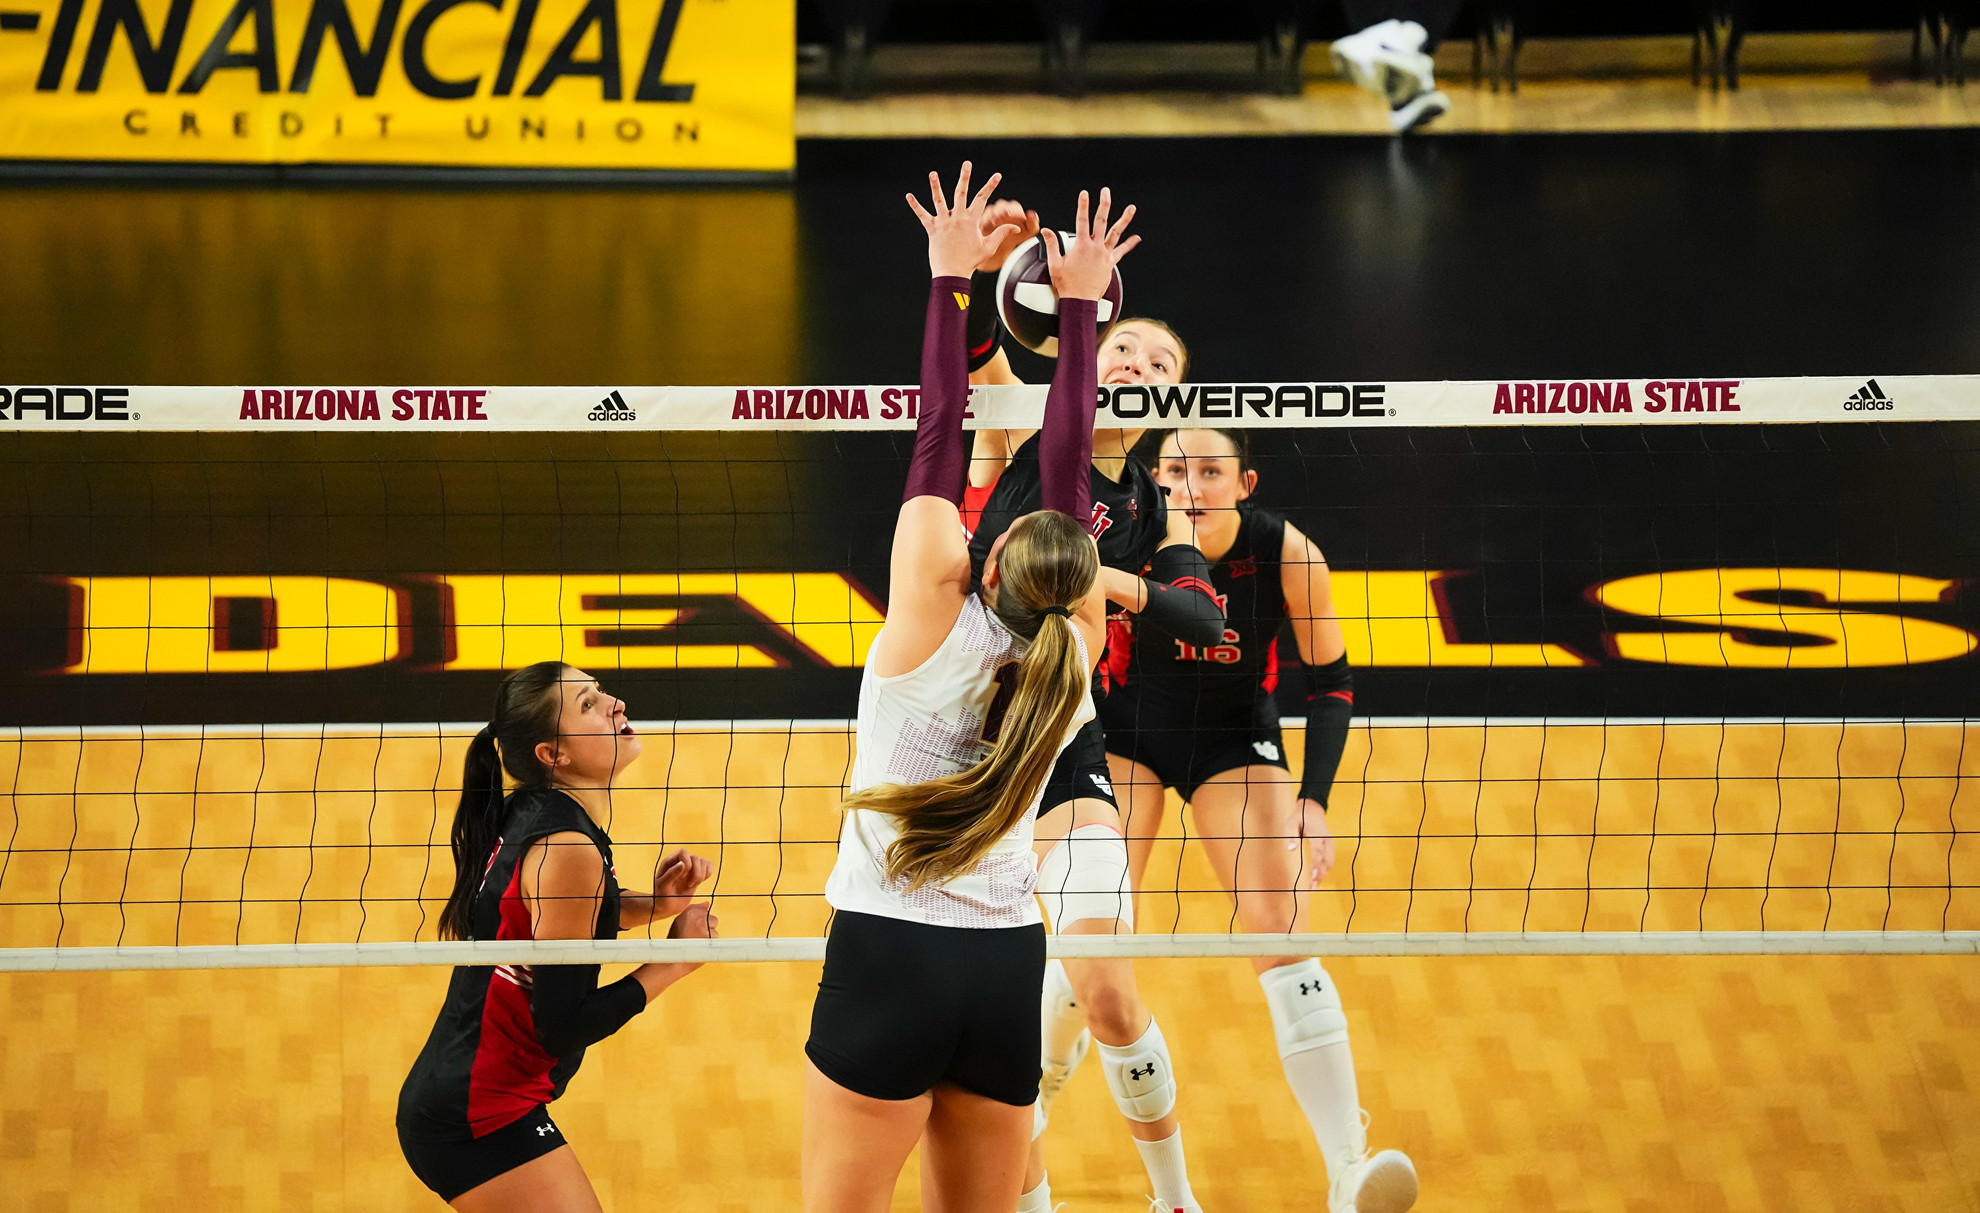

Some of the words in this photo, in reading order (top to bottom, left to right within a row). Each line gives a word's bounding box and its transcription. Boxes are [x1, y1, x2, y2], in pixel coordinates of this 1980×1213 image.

[123, 109, 392, 138] CREDIT
[465, 114, 699, 143] UNION
[239, 389, 381, 421] ARIZONA
[391, 389, 488, 421] STATE
[731, 388, 870, 420] ARIZONA
[1492, 382, 1634, 415] ARIZONA
[1643, 380, 1742, 413] STATE
[1843, 398, 1894, 411] adidas
[587, 409, 637, 421] adidas
[63, 568, 1979, 675] DELS
